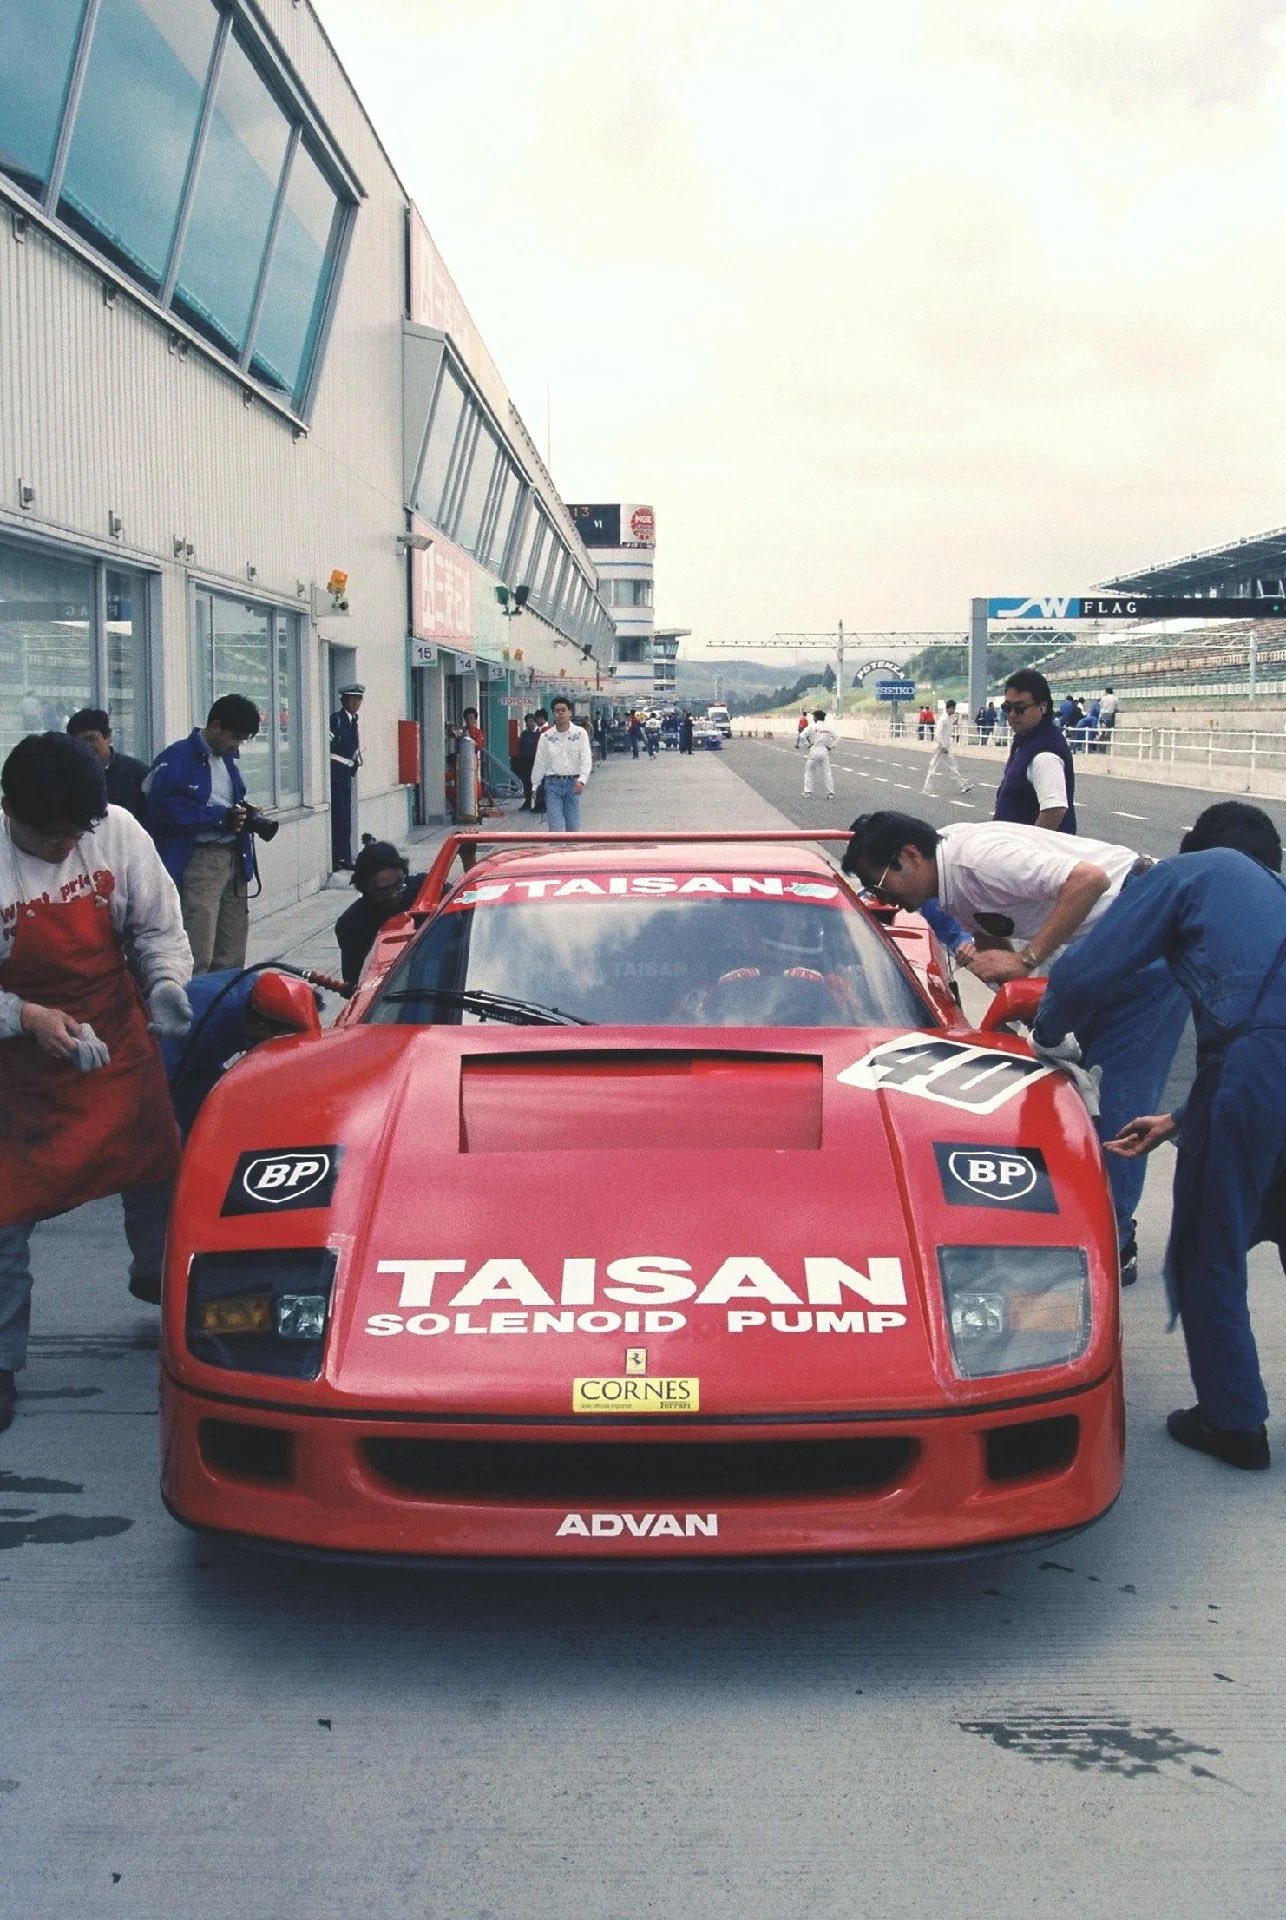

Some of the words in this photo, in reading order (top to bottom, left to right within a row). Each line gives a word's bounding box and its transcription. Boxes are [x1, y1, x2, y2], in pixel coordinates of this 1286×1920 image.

[634, 515, 653, 524] NGK
[1083, 601, 1138, 614] FLAG
[417, 647, 432, 660] 15
[459, 659, 472, 669] 14
[491, 668, 503, 677] 13
[856, 660, 906, 681] POTENZA
[880, 686, 915, 695] SEIKO
[502, 697, 532, 705] TOYOTA
[515, 876, 784, 897] TAISAN
[868, 1041, 1045, 1104] 40
[253, 1161, 320, 1189] BP
[967, 1159, 1027, 1185] BP
[376, 1256, 908, 1308] TAISAN
[364, 1310, 687, 1336] SOLENOID
[727, 1310, 907, 1334] PUMP
[580, 1380, 691, 1400] CORNES
[555, 1513, 718, 1537] ADVAN
